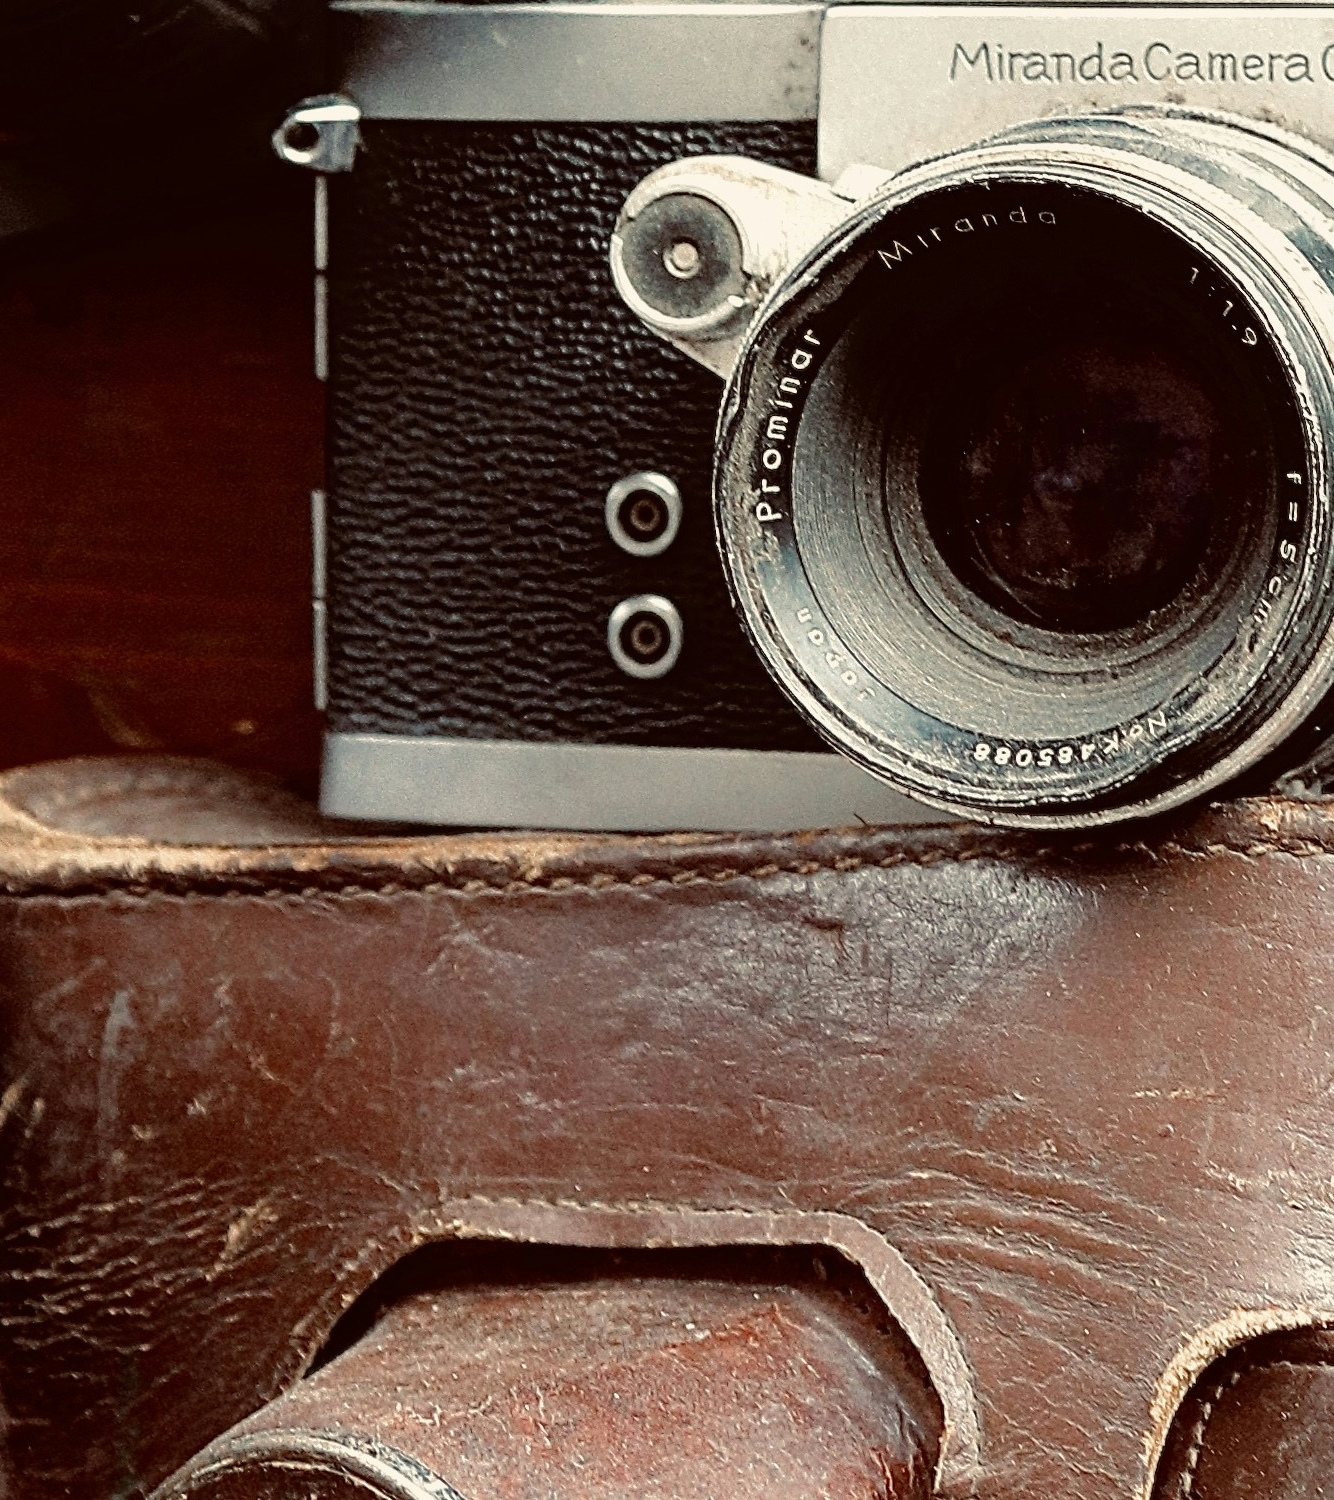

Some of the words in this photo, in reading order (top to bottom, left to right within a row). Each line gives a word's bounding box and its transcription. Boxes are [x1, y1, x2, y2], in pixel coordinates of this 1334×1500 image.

[948, 40, 1138, 85] Miranda
[1142, 40, 1314, 85] Camera
[755, 328, 822, 524] Prominar
[877, 206, 1059, 270] Miranda
